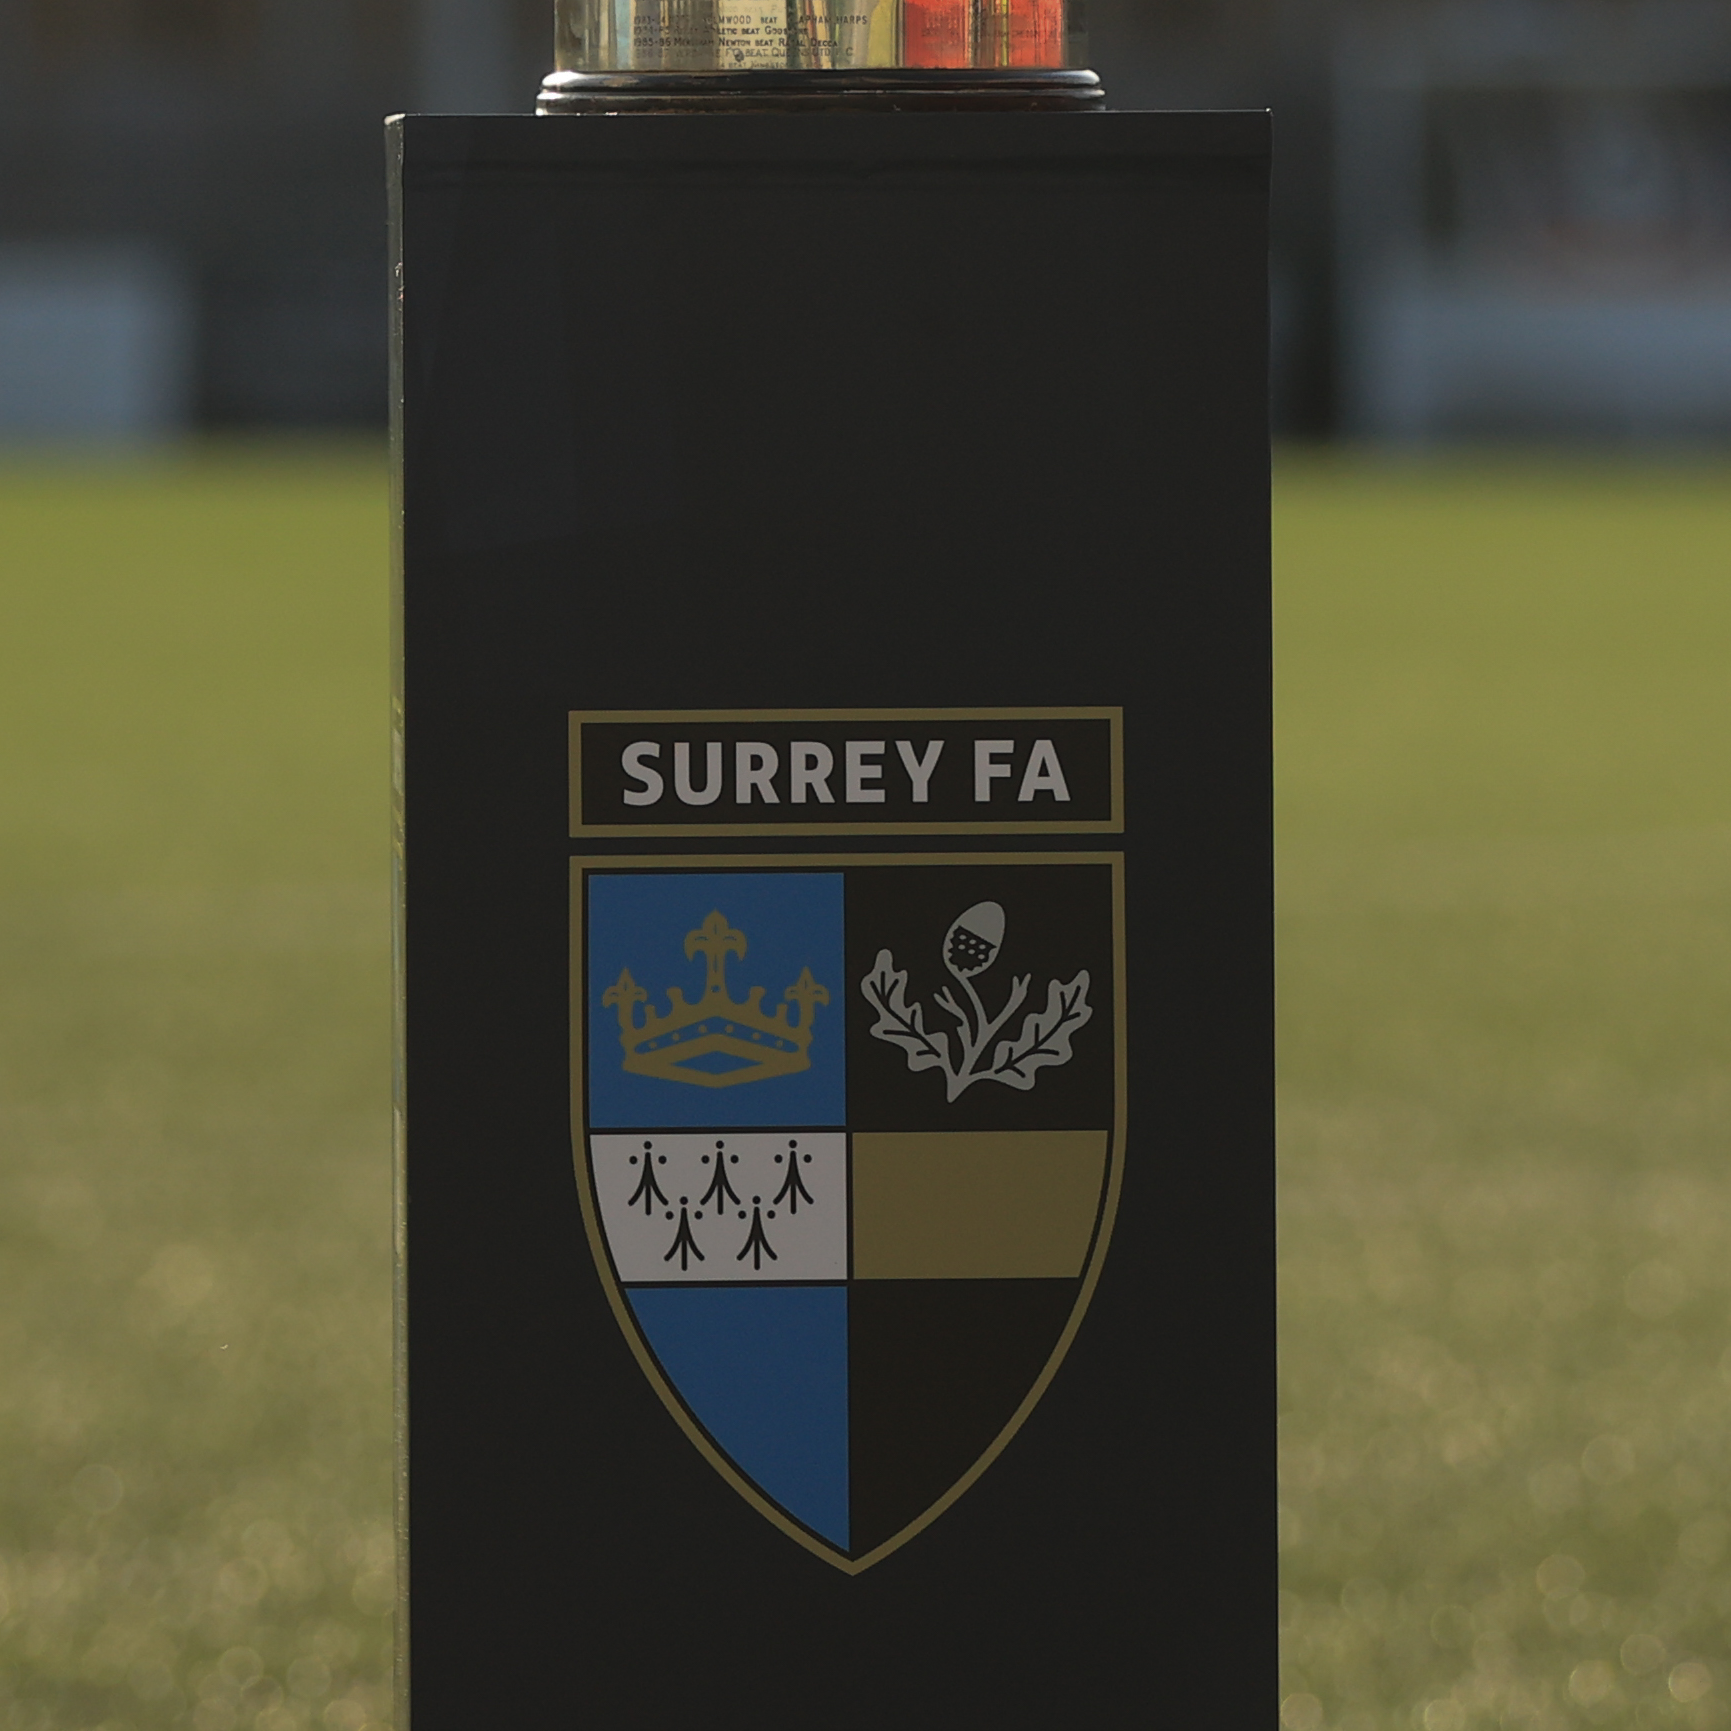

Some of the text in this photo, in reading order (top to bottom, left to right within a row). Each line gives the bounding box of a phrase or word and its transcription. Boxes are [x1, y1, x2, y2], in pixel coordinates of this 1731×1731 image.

[760, 16, 778, 24] BEAT
[788, 15, 831, 25] APHAM
[836, 15, 868, 25] HARPS
[741, 27, 761, 35] BEAT
[633, 37, 671, 46] 1985-86
[754, 39, 774, 47] BEAT
[778, 37, 806, 47] RAAL
[745, 48, 769, 57] BEAT
[771, 47, 810, 58] QUES
[621, 738, 1071, 807] SURREY FA
